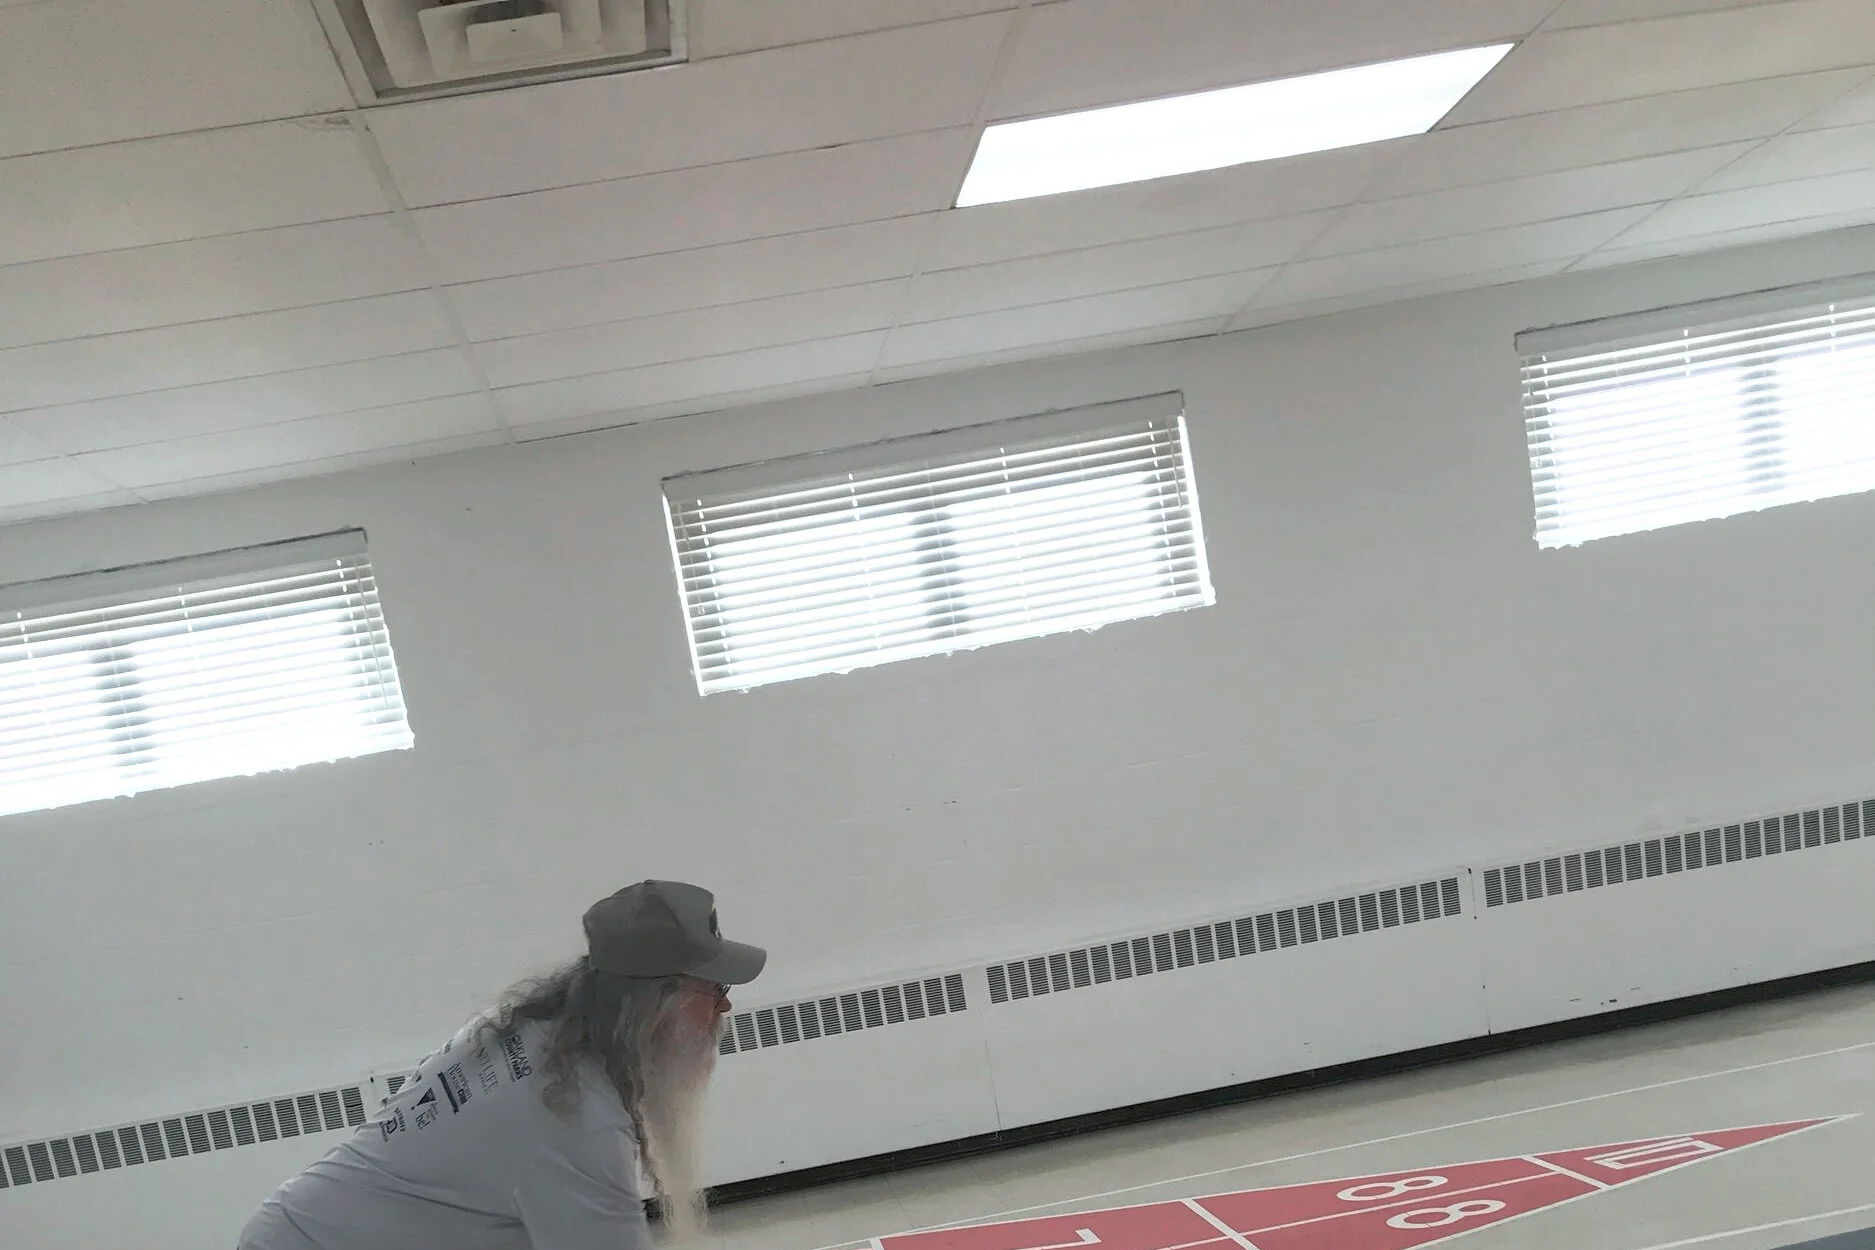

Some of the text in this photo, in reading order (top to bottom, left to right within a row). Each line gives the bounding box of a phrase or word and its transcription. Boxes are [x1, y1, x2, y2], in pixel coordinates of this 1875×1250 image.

[512, 1034, 532, 1077] OAKLAND
[1583, 1137, 1725, 1170] 10
[1336, 1176, 1448, 1201] 8
[1386, 1199, 1506, 1229] 8
